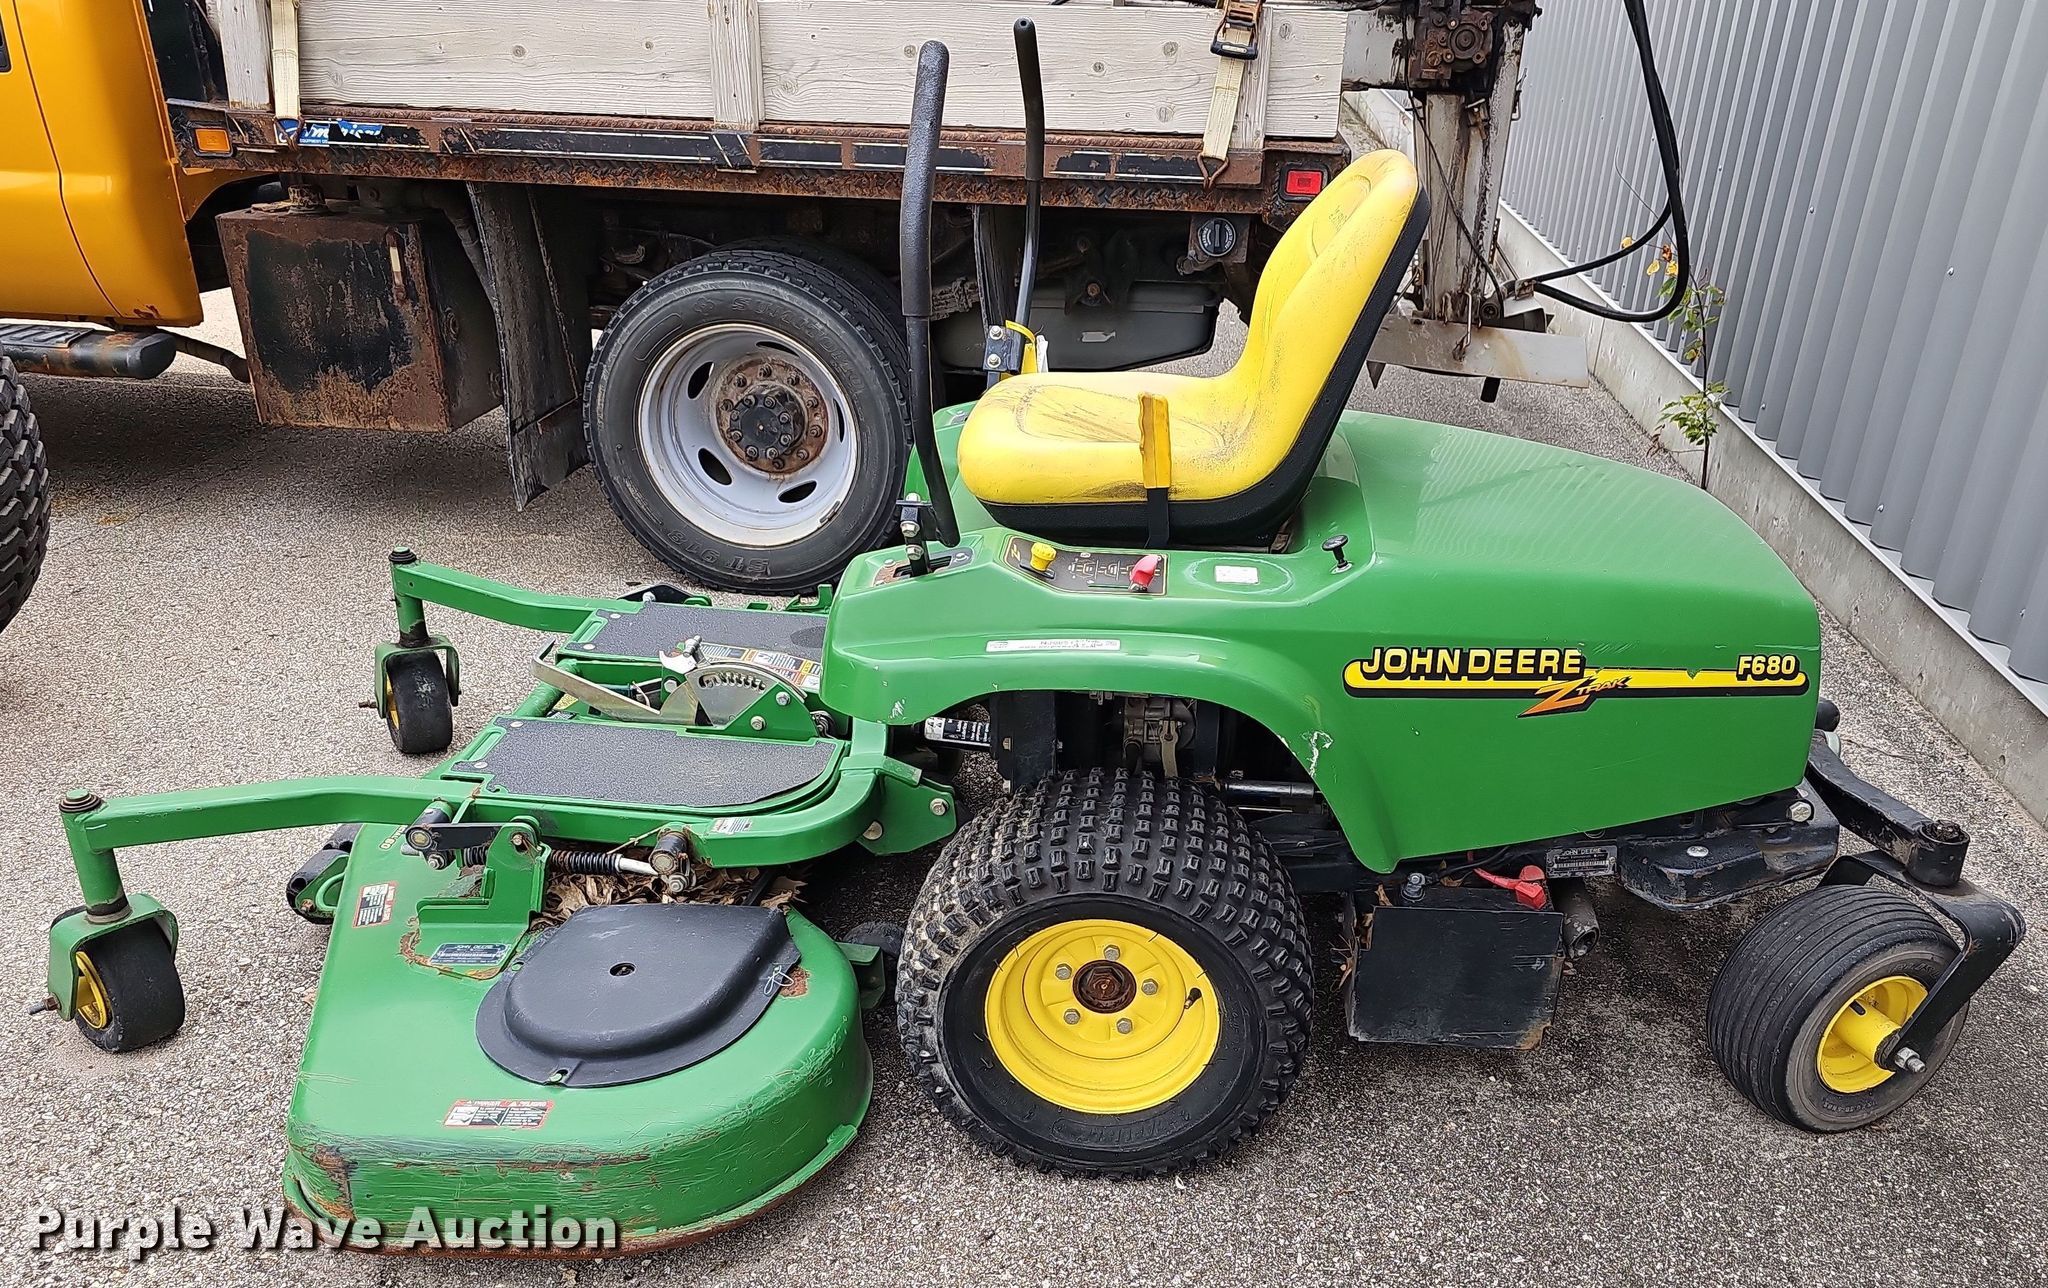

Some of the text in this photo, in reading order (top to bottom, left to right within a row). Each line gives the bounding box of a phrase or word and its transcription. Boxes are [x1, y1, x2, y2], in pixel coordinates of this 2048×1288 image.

[1362, 648, 1583, 675] JOHN DEERE
[1738, 655, 1797, 676] F680
